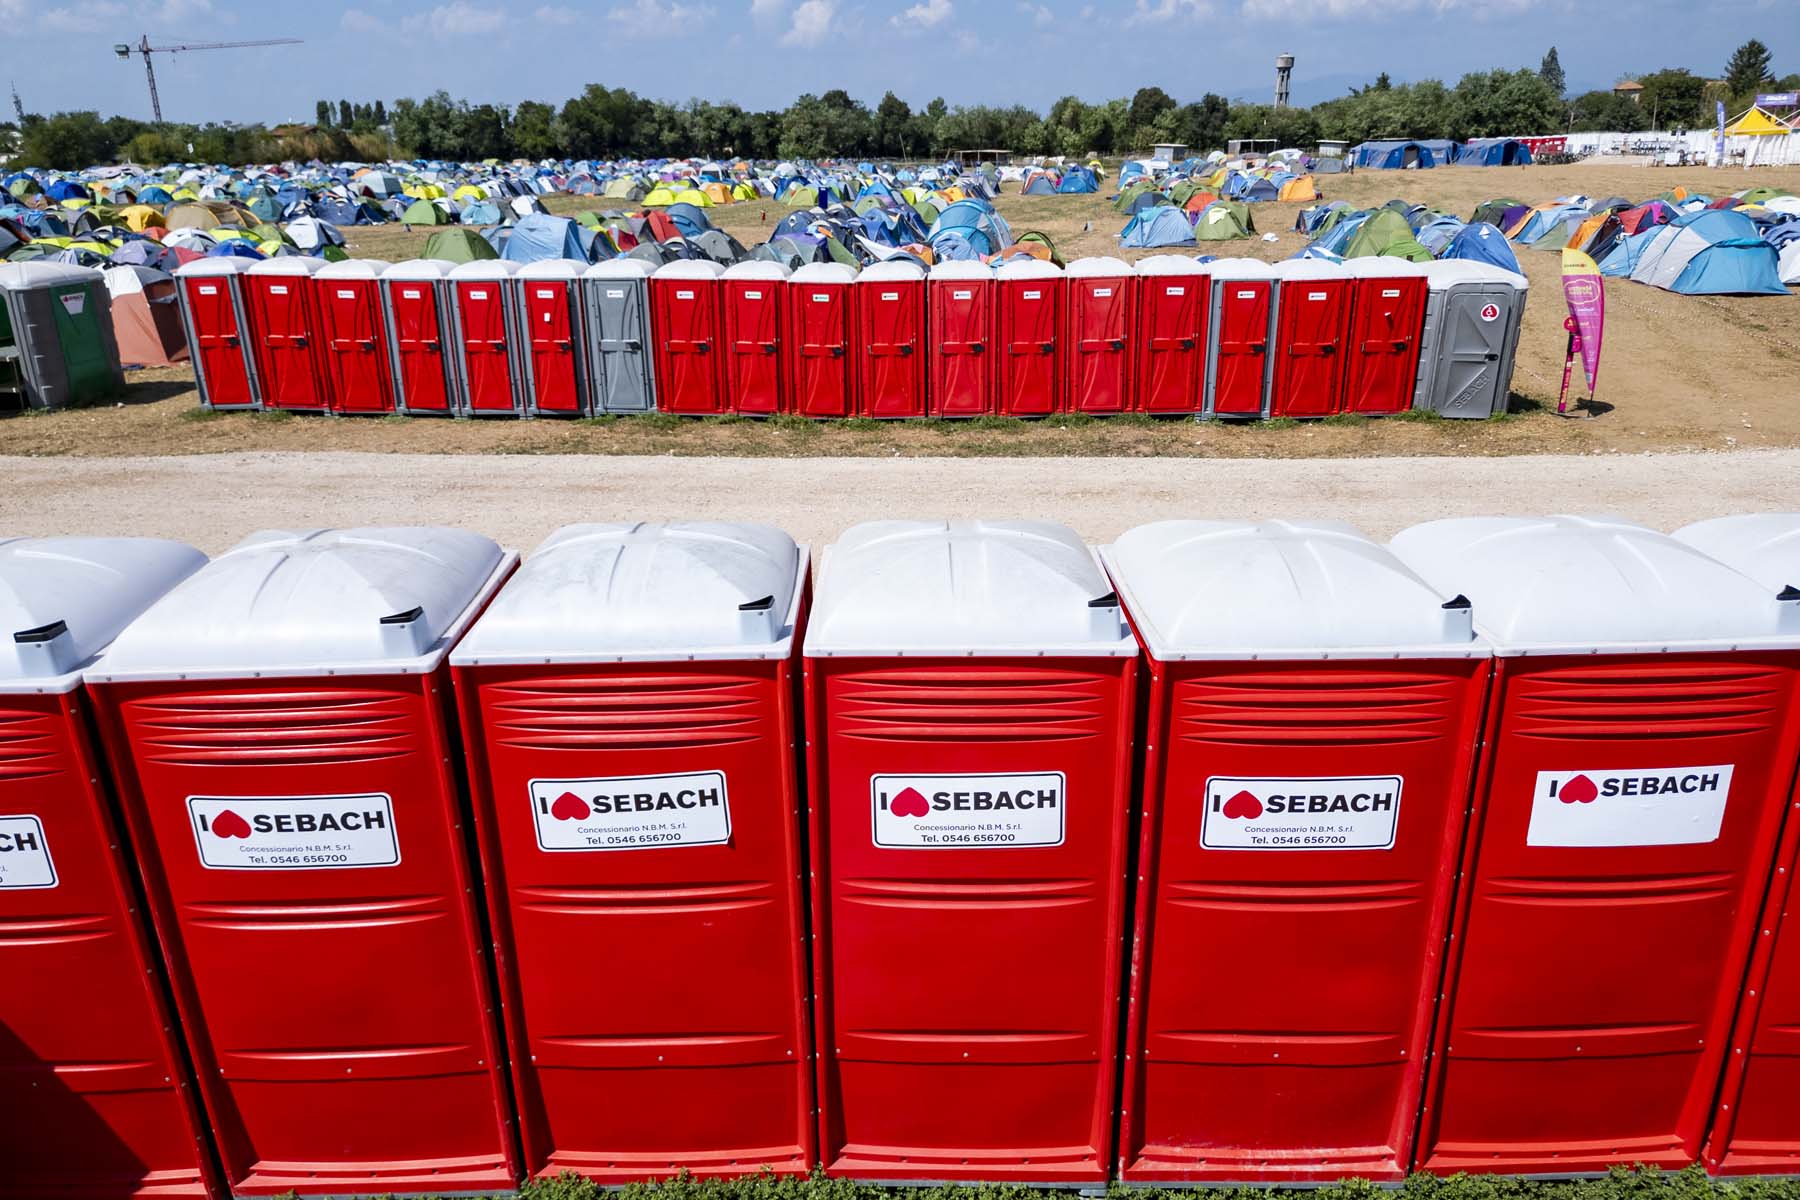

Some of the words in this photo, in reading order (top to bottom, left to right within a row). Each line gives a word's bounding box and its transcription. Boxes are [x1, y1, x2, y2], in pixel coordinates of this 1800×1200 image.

[1549, 780, 1559, 798] I
[1600, 773, 1720, 797] SEBACH
[540, 796, 549, 815] I
[592, 787, 719, 814] SEBACH
[880, 792, 888, 811] I
[931, 789, 1057, 812] SEBACH
[1212, 794, 1221, 813] I
[1265, 792, 1393, 814] SEBACH
[199, 814, 209, 832] I
[253, 810, 386, 834] SEBACH
[577, 826, 640, 834] Concessionario
[585, 837, 604, 845] Tel.
[607, 836, 636, 844] 0546
[639, 833, 681, 843] 656700
[921, 834, 939, 843] Tel.
[942, 834, 971, 842] 0546
[973, 834, 1015, 842] 656700
[1251, 836, 1269, 844] Tel.
[1272, 836, 1301, 844] 0546
[1303, 836, 1346, 844] 656700
[239, 845, 304, 853] Concessionario
[248, 856, 268, 864] Tel.
[270, 856, 300, 864] 0546
[303, 854, 348, 863] 656700
